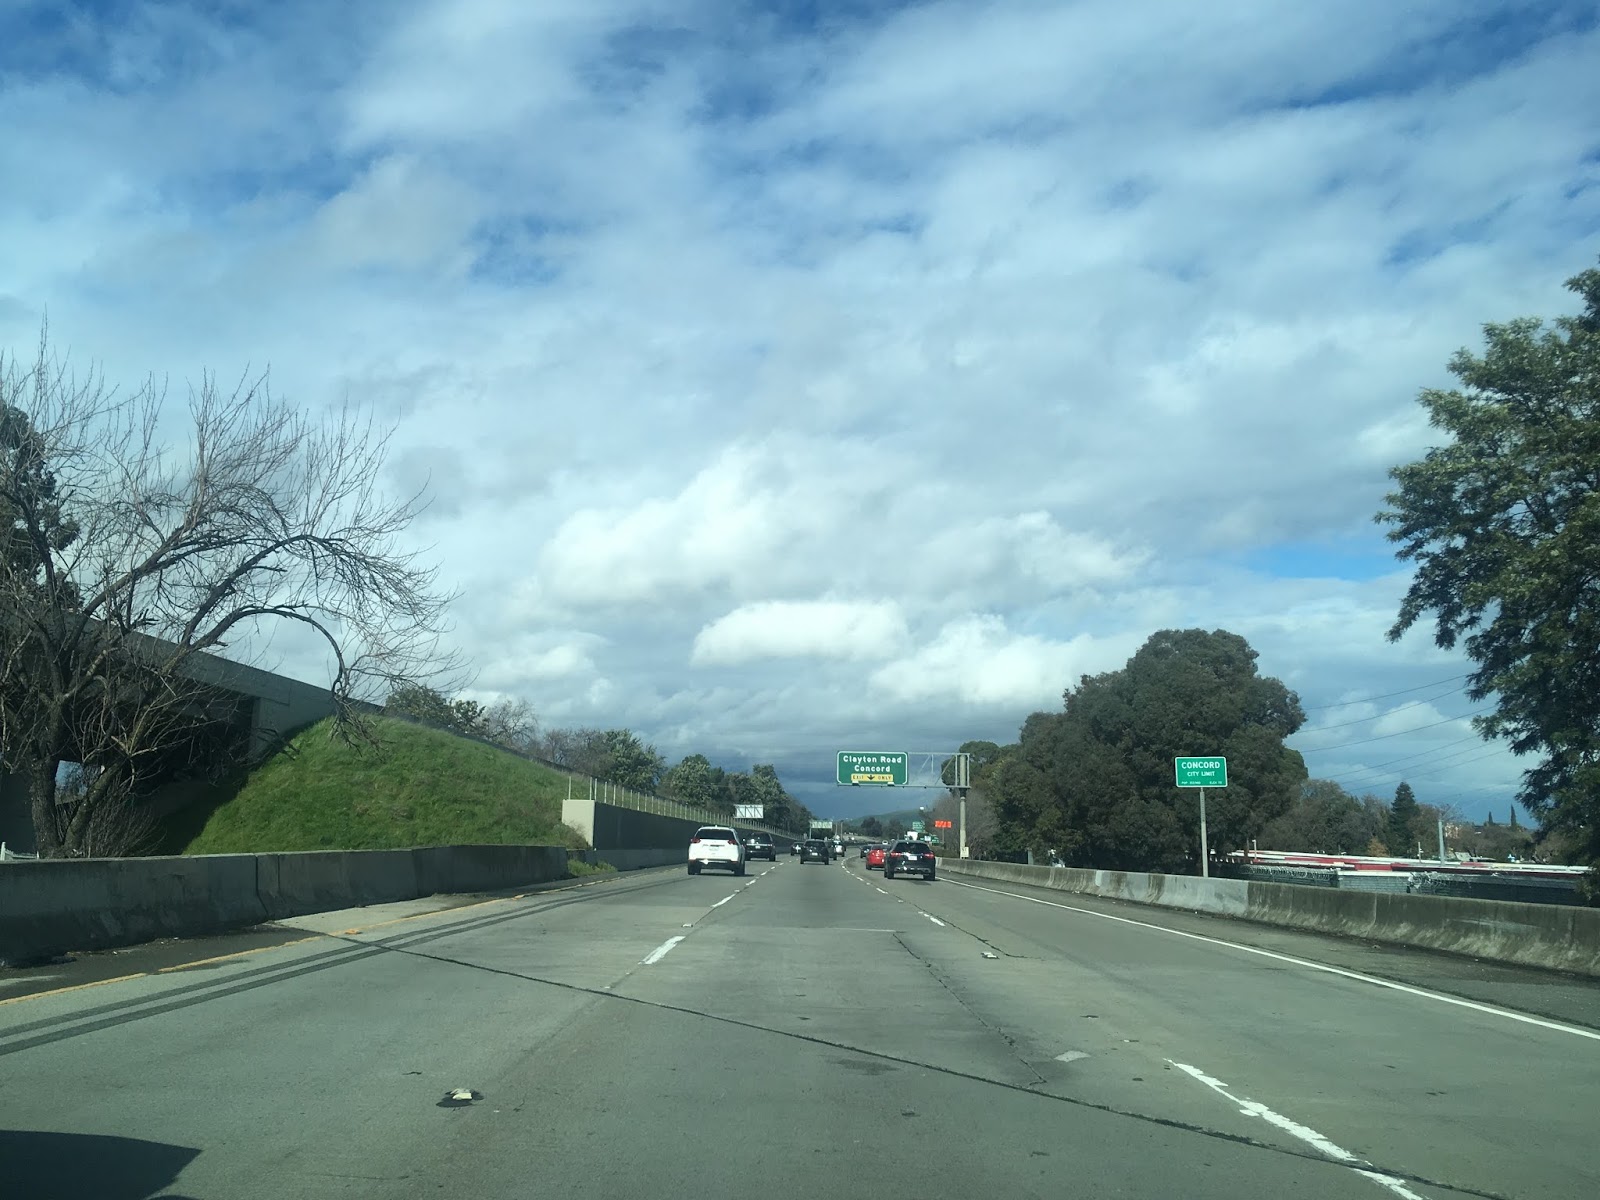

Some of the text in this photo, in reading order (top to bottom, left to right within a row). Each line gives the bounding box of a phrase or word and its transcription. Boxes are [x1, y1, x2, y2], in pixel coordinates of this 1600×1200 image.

[843, 755, 877, 764] Clayton
[854, 764, 891, 772] Concord
[1181, 761, 1220, 769] CONCORD
